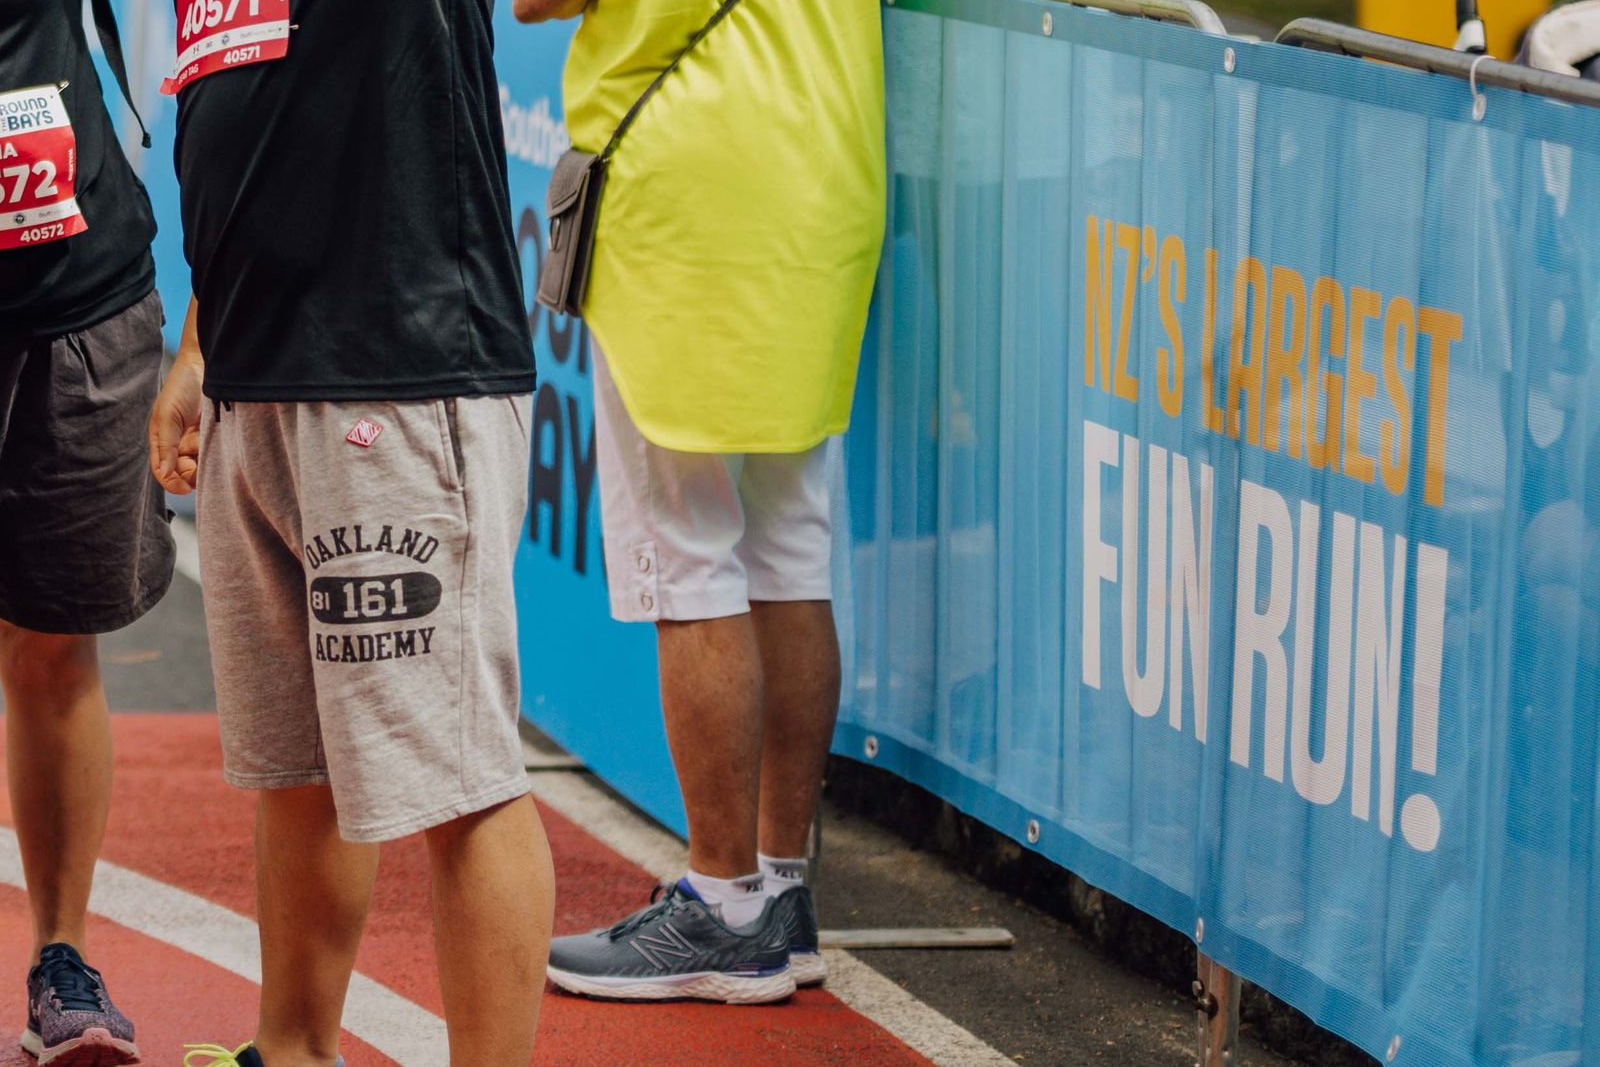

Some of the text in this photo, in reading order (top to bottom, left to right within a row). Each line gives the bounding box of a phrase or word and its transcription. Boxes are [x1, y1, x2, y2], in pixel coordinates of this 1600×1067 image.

[223, 45, 261, 65] 40571
[8, 110, 53, 132] BAYS
[20, 223, 64, 242] 40572
[1084, 214, 1463, 508] NZ'S LARGEST
[305, 525, 440, 570] OAKLAND
[343, 578, 408, 619] 161
[316, 626, 436, 663] ACADEMY
[1082, 419, 1449, 852] FUN RUN!
